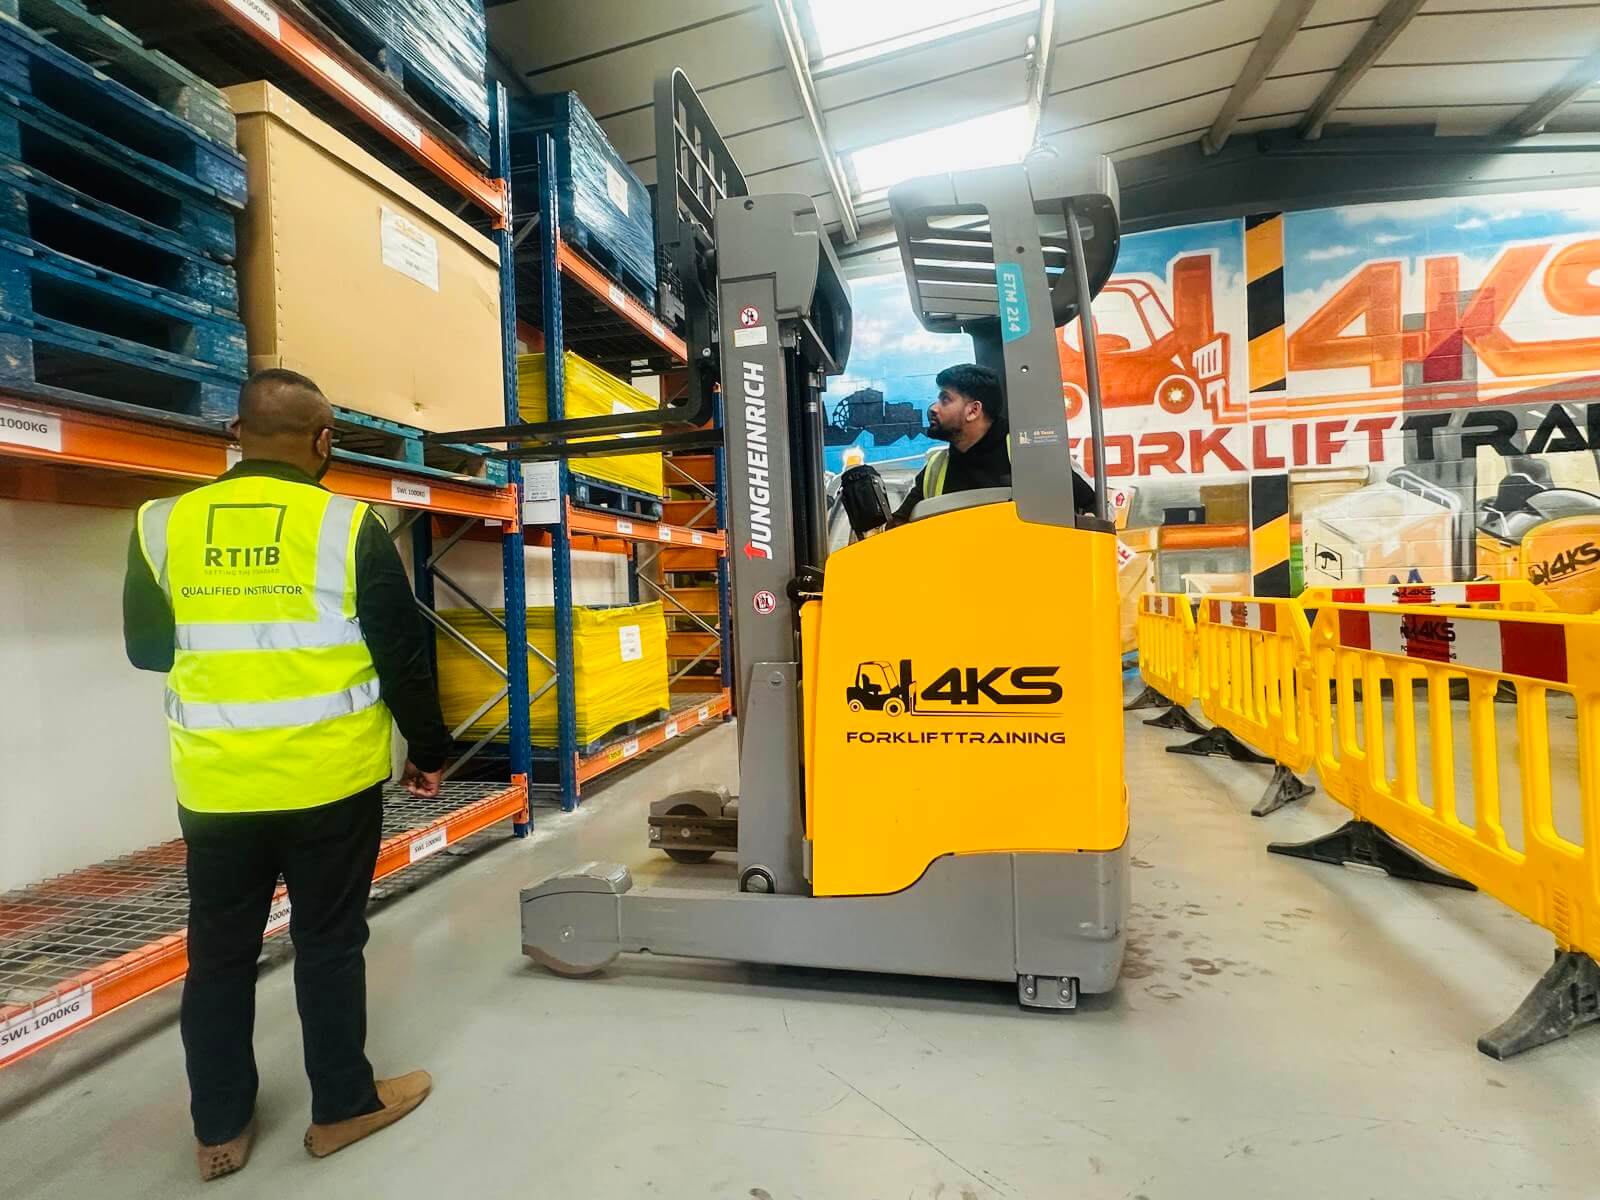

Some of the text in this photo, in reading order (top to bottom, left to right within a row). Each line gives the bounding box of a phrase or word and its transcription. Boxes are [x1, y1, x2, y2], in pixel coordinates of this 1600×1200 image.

[1003, 272, 1021, 332] ETM 214
[743, 361, 773, 561] JUNGHEINRICH
[205, 547, 280, 567] RTITB
[1550, 542, 1600, 575] 4KS
[181, 585, 303, 597] QUALIFIED INSTRUCTOR
[1419, 621, 1456, 642] 4KS
[920, 666, 1063, 705] 4KS
[1, 1001, 80, 1046] SWL 1000KG
